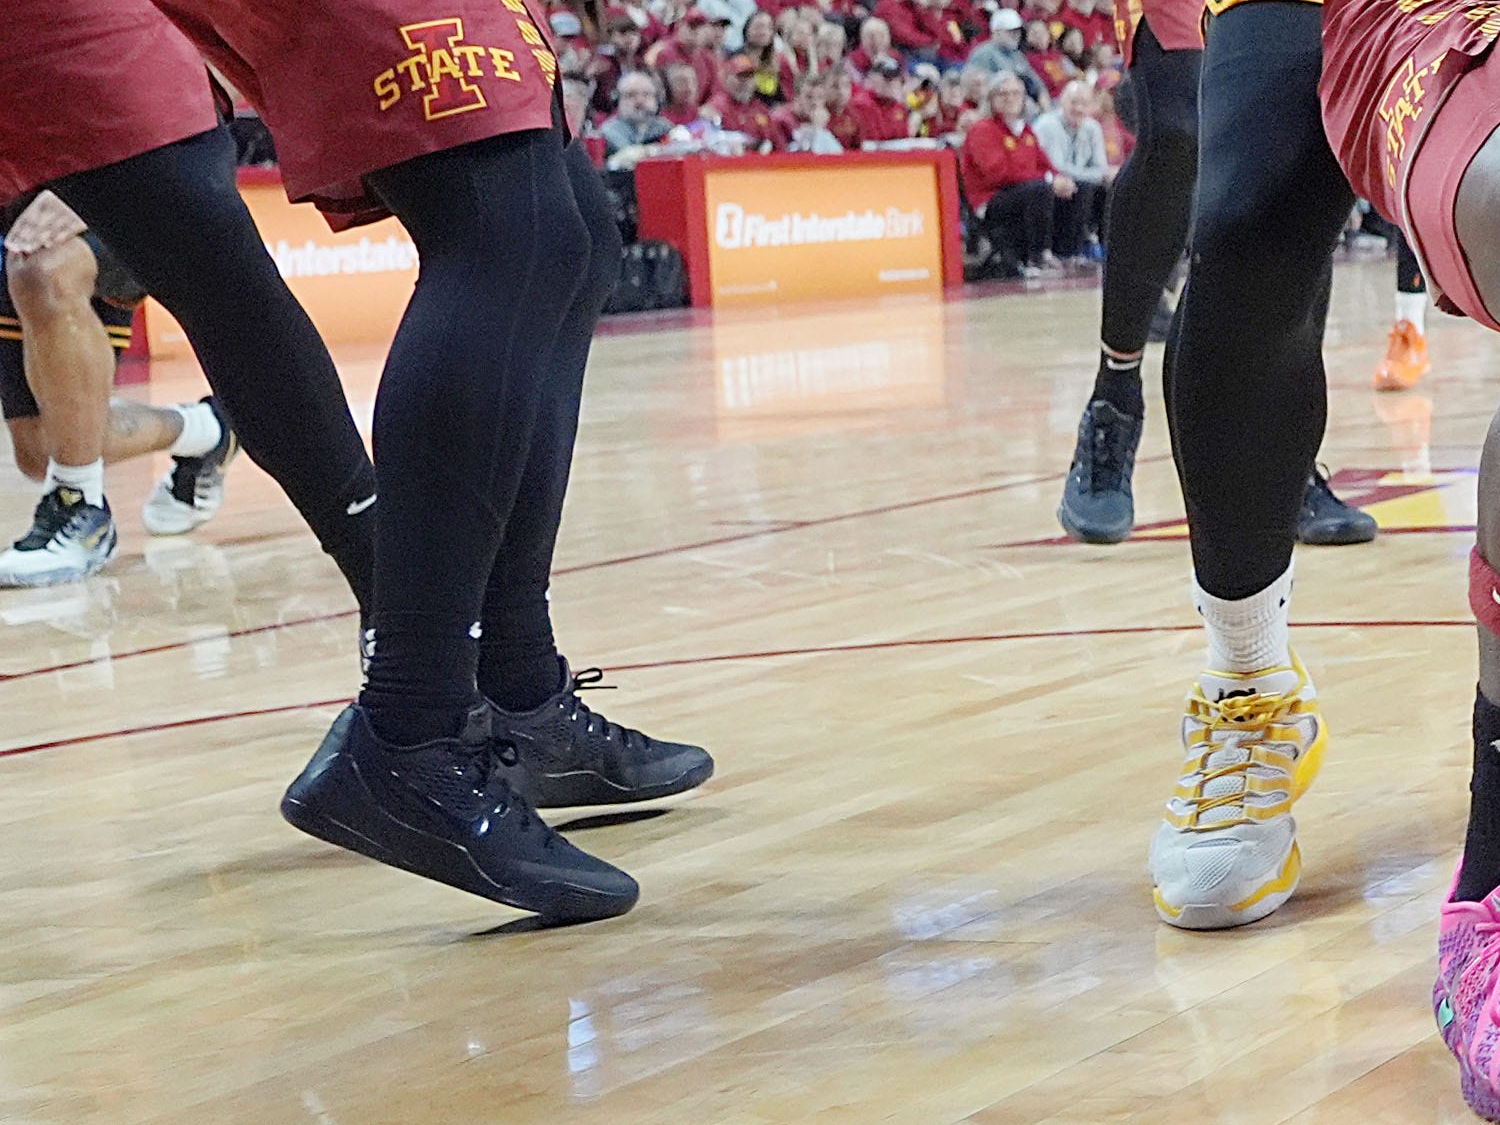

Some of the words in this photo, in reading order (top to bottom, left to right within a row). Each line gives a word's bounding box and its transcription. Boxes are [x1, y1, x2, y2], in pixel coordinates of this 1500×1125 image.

[373, 45, 521, 111] STATE
[743, 212, 790, 247] First
[791, 209, 885, 245] Interstate
[276, 236, 418, 279] Interstate
